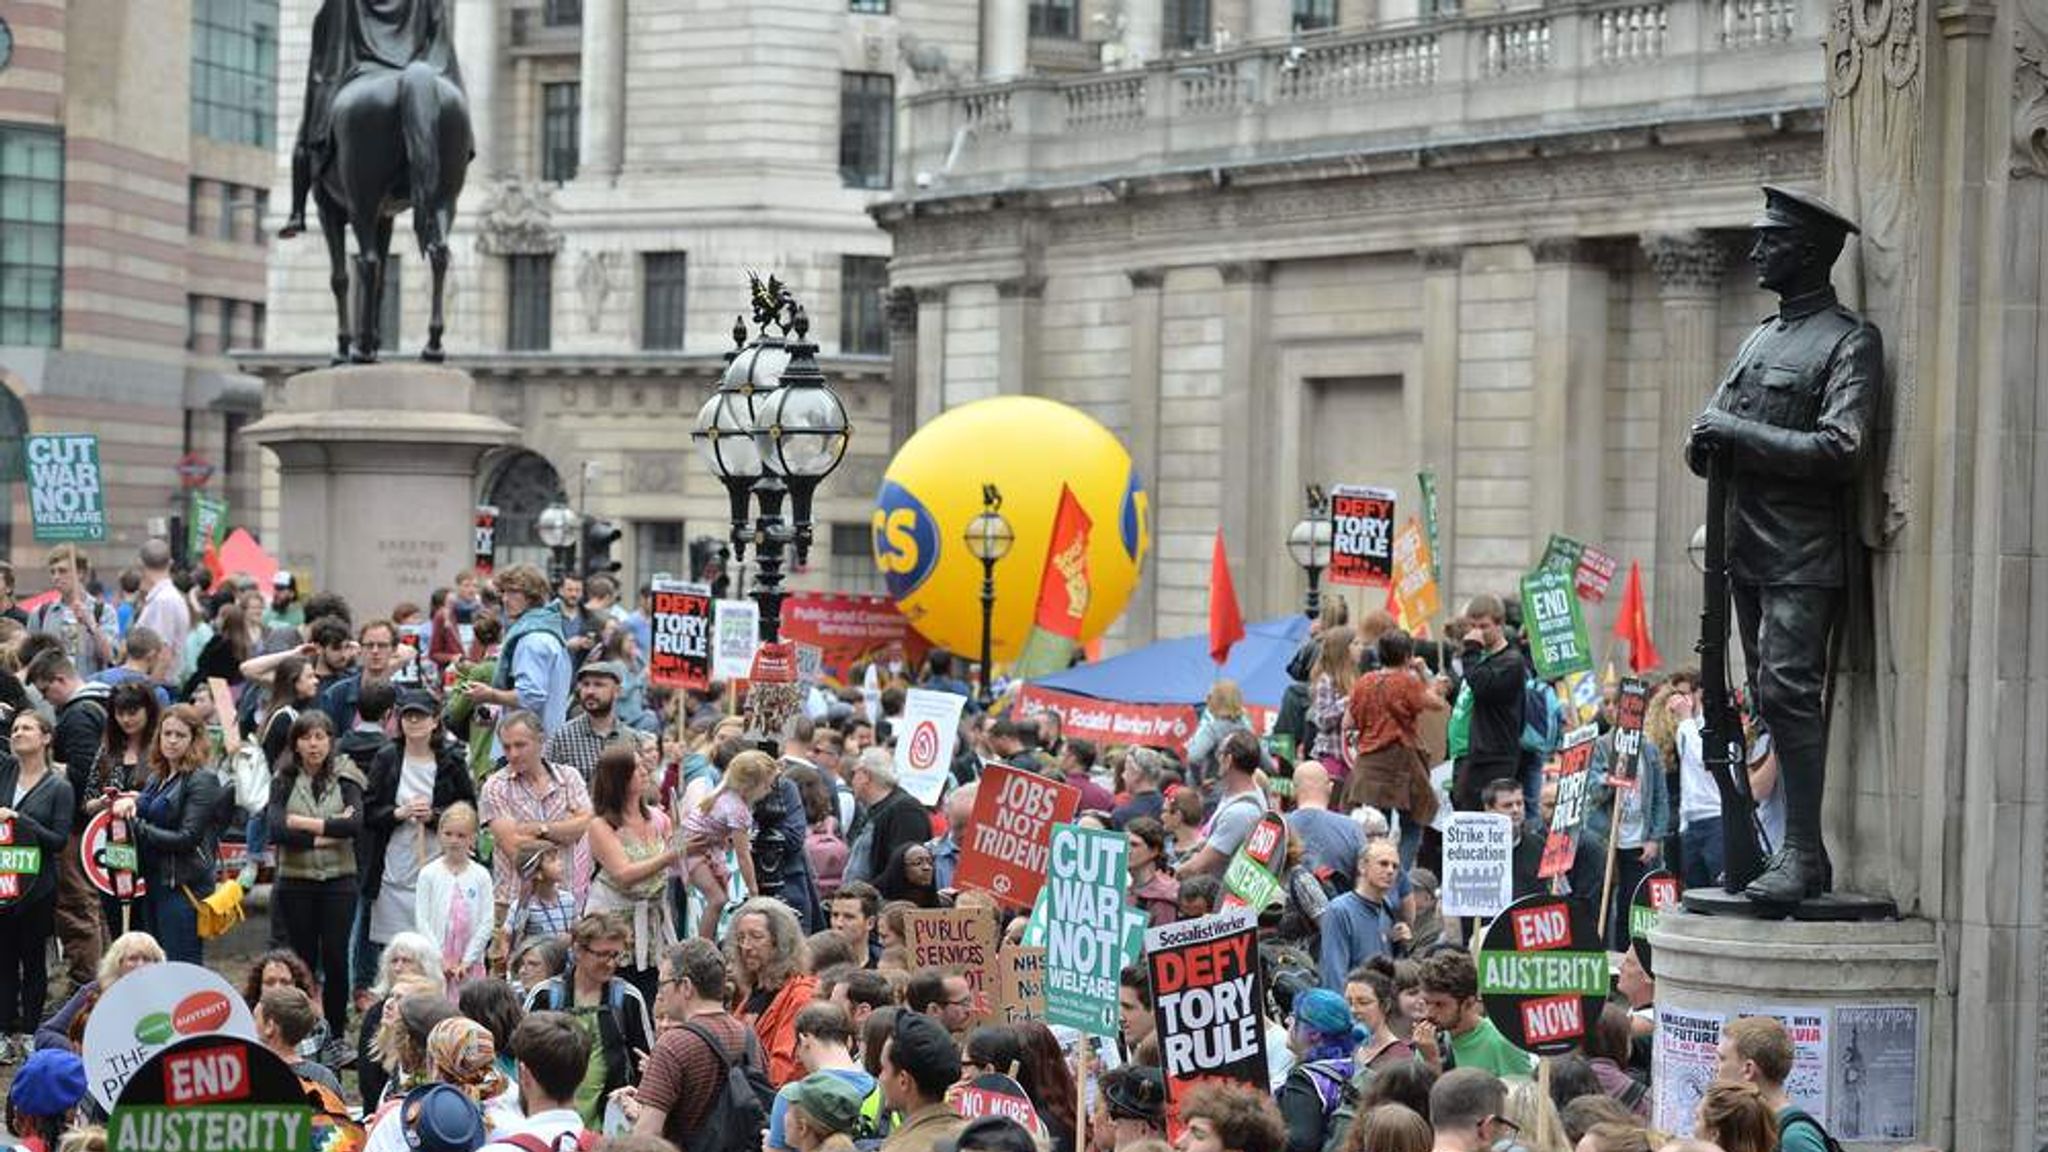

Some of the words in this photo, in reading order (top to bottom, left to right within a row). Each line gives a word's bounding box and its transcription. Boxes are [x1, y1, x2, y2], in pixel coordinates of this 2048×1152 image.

[29, 437, 96, 464] CUT
[31, 461, 99, 492] WAR
[32, 487, 96, 513] NOT
[1336, 499, 1390, 519] DEFY
[1335, 515, 1389, 539] TORY
[1335, 533, 1389, 558] RULE
[655, 593, 708, 616] DEFY
[1532, 589, 1570, 620] END
[654, 612, 708, 638] TORY
[655, 633, 707, 658] RULE
[996, 774, 1059, 821] JOBS
[996, 807, 1046, 841] NOT
[1447, 826, 1485, 843] Strike
[1488, 827, 1505, 843] for
[972, 822, 1050, 876] TRIDENT
[1052, 829, 1125, 887] CUT
[1447, 846, 1507, 861] education
[1052, 876, 1120, 931] WAR
[915, 918, 977, 944] PUBLIC
[1517, 910, 1568, 949] END
[915, 945, 985, 968] SERVICES
[1049, 919, 1118, 979] NOT
[1154, 934, 1251, 994] DEFY
[964, 969, 985, 992] OT
[1049, 966, 1116, 1001] WELFARE
[1484, 951, 1603, 991] AUSTERITY
[175, 1000, 228, 1028] AUSTERITY
[1158, 974, 1255, 1035] TORY
[1526, 999, 1582, 1039] NOW
[1165, 1013, 1260, 1078] RULE
[1673, 1028, 1720, 1046] FUTURE
[170, 1052, 243, 1102] END
[962, 1091, 984, 1118] NO
[991, 1097, 1030, 1124] MORE
[117, 1110, 302, 1151] AUSTERITY
